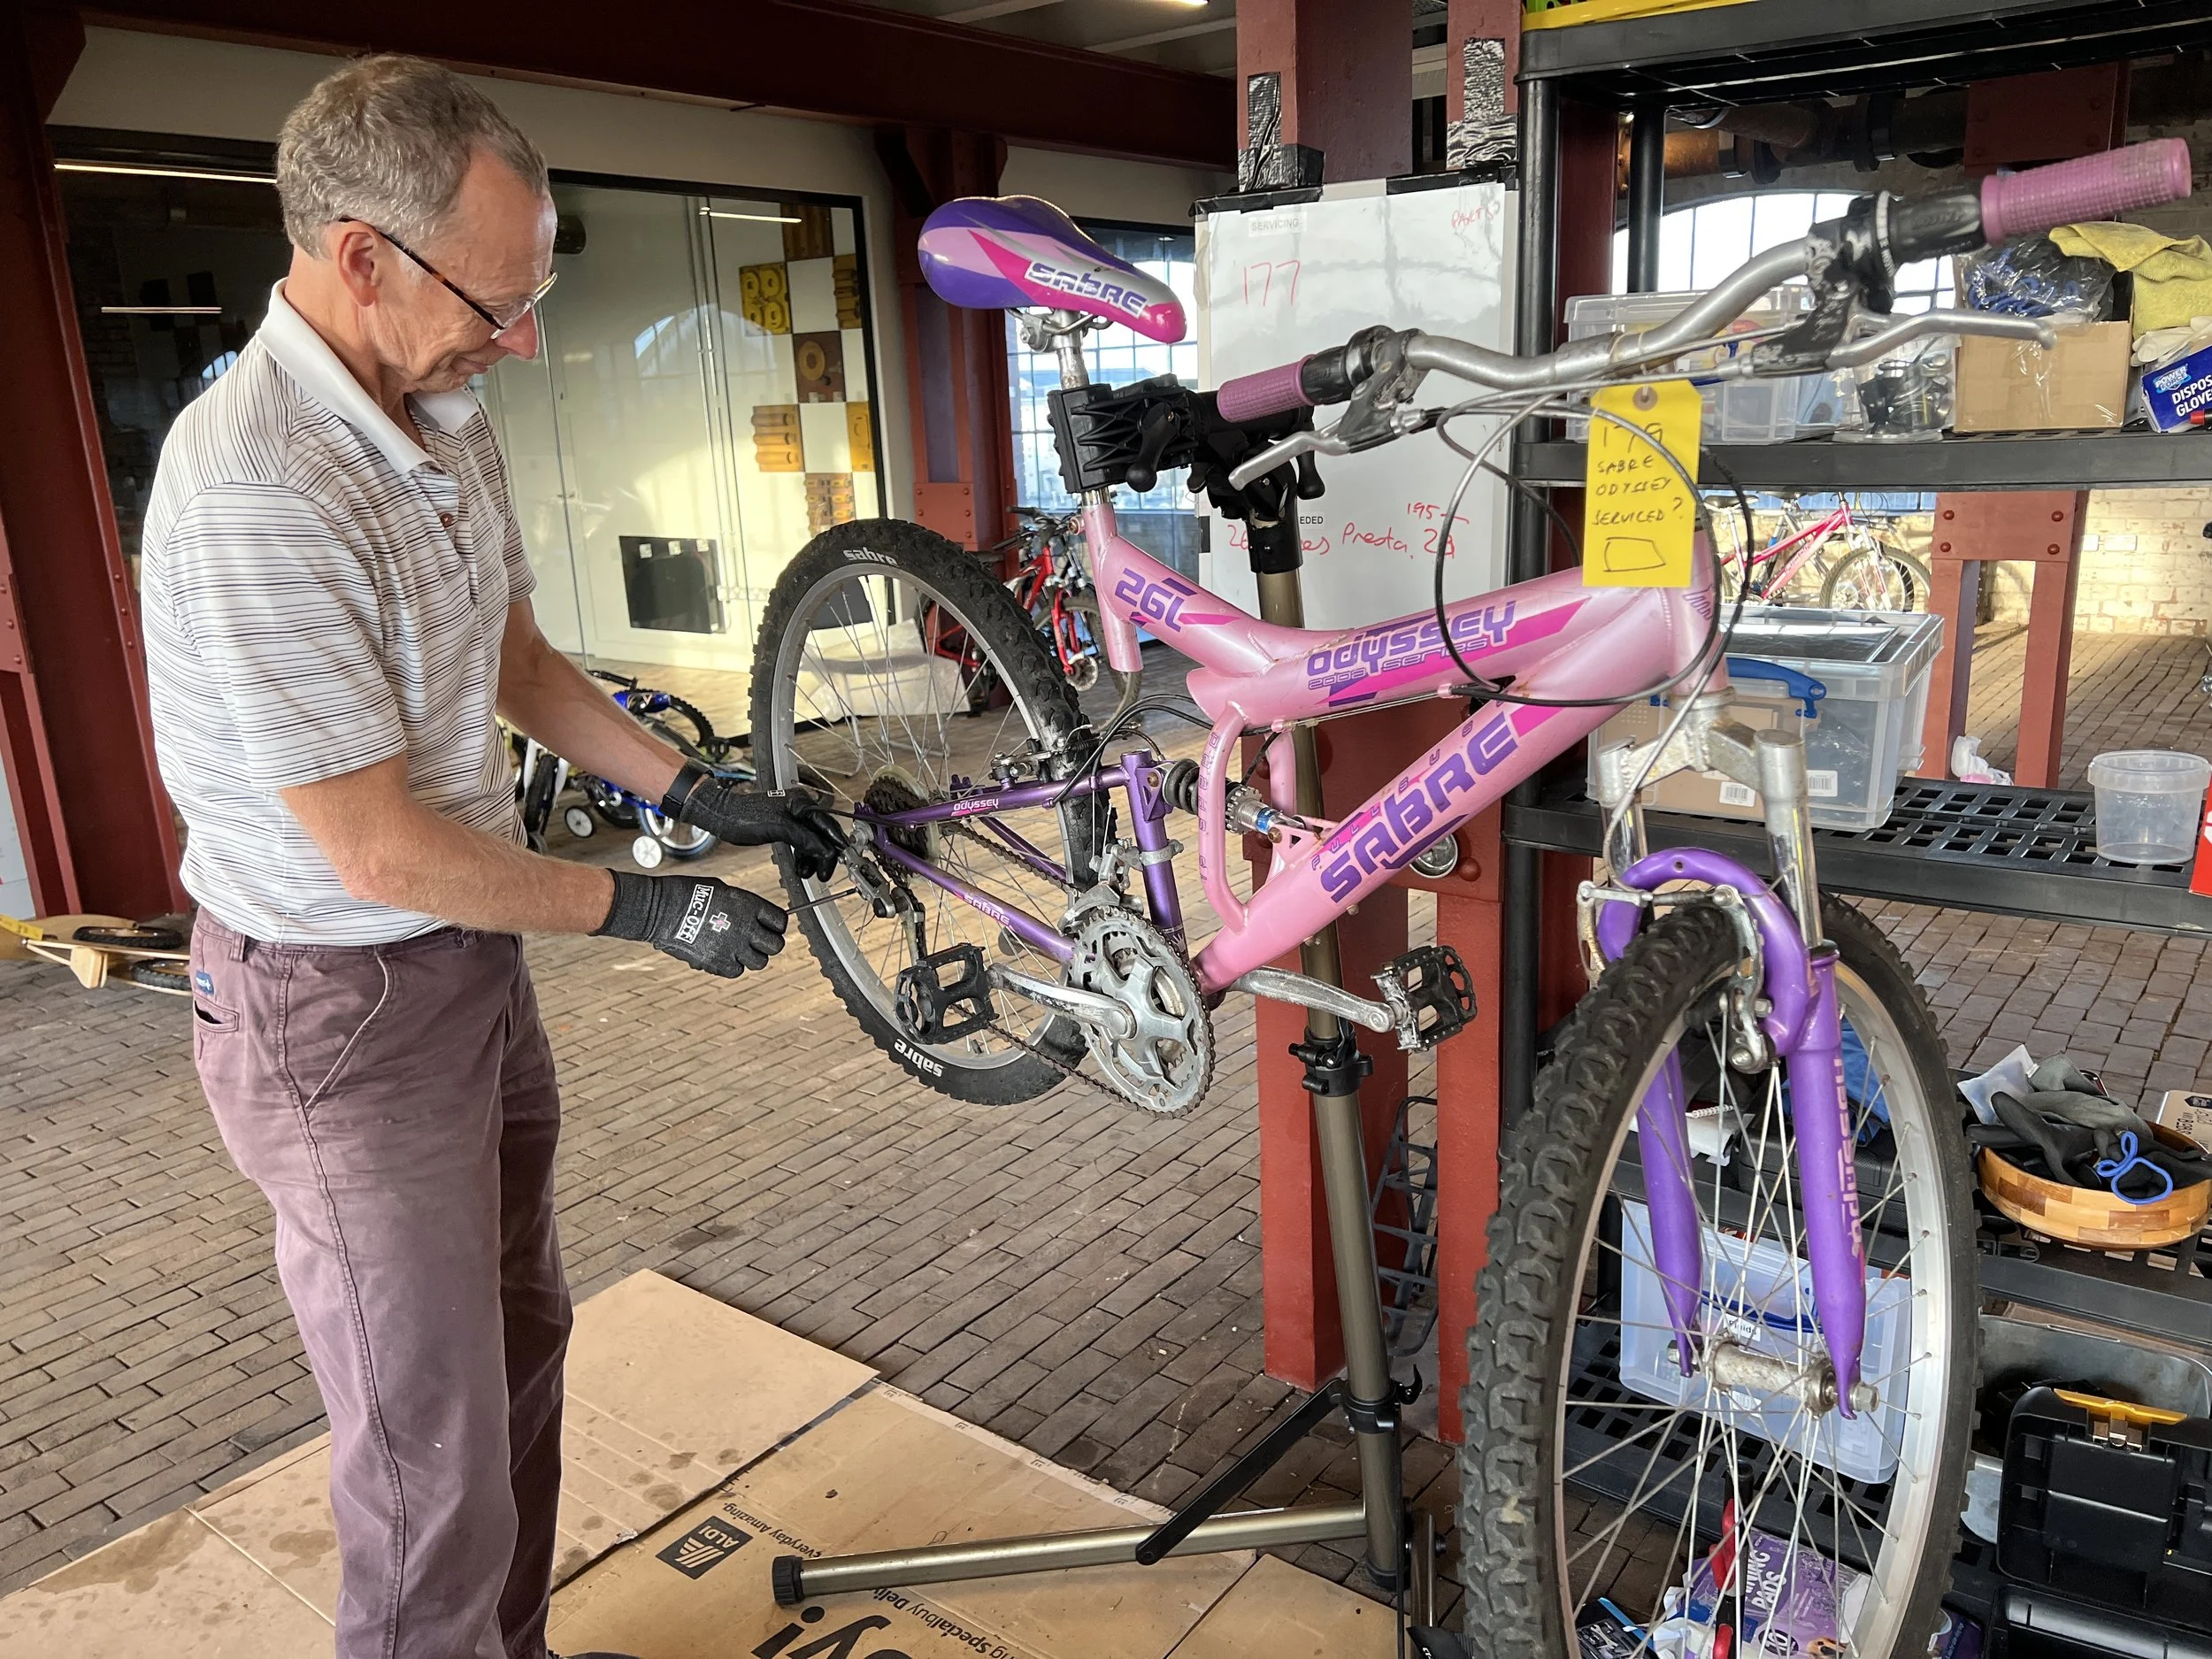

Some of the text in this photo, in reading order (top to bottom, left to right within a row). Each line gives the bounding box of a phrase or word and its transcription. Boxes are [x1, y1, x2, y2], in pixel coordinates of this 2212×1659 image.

[1251, 218, 1300, 231] SERVICING
[1027, 262, 1149, 315] SABRE
[1242, 259, 1301, 306] 177
[1597, 455, 1655, 474] SABRE
[1595, 477, 1671, 496] ODYSSEY
[1299, 516, 1325, 525] EDED
[1319, 710, 1519, 904] SABRE
[964, 893, 1011, 926] SABRE
[894, 1038, 945, 1078] sabre
[697, 1524, 741, 1549] ALDI
[906, 1601, 993, 1654] Specialbuy
